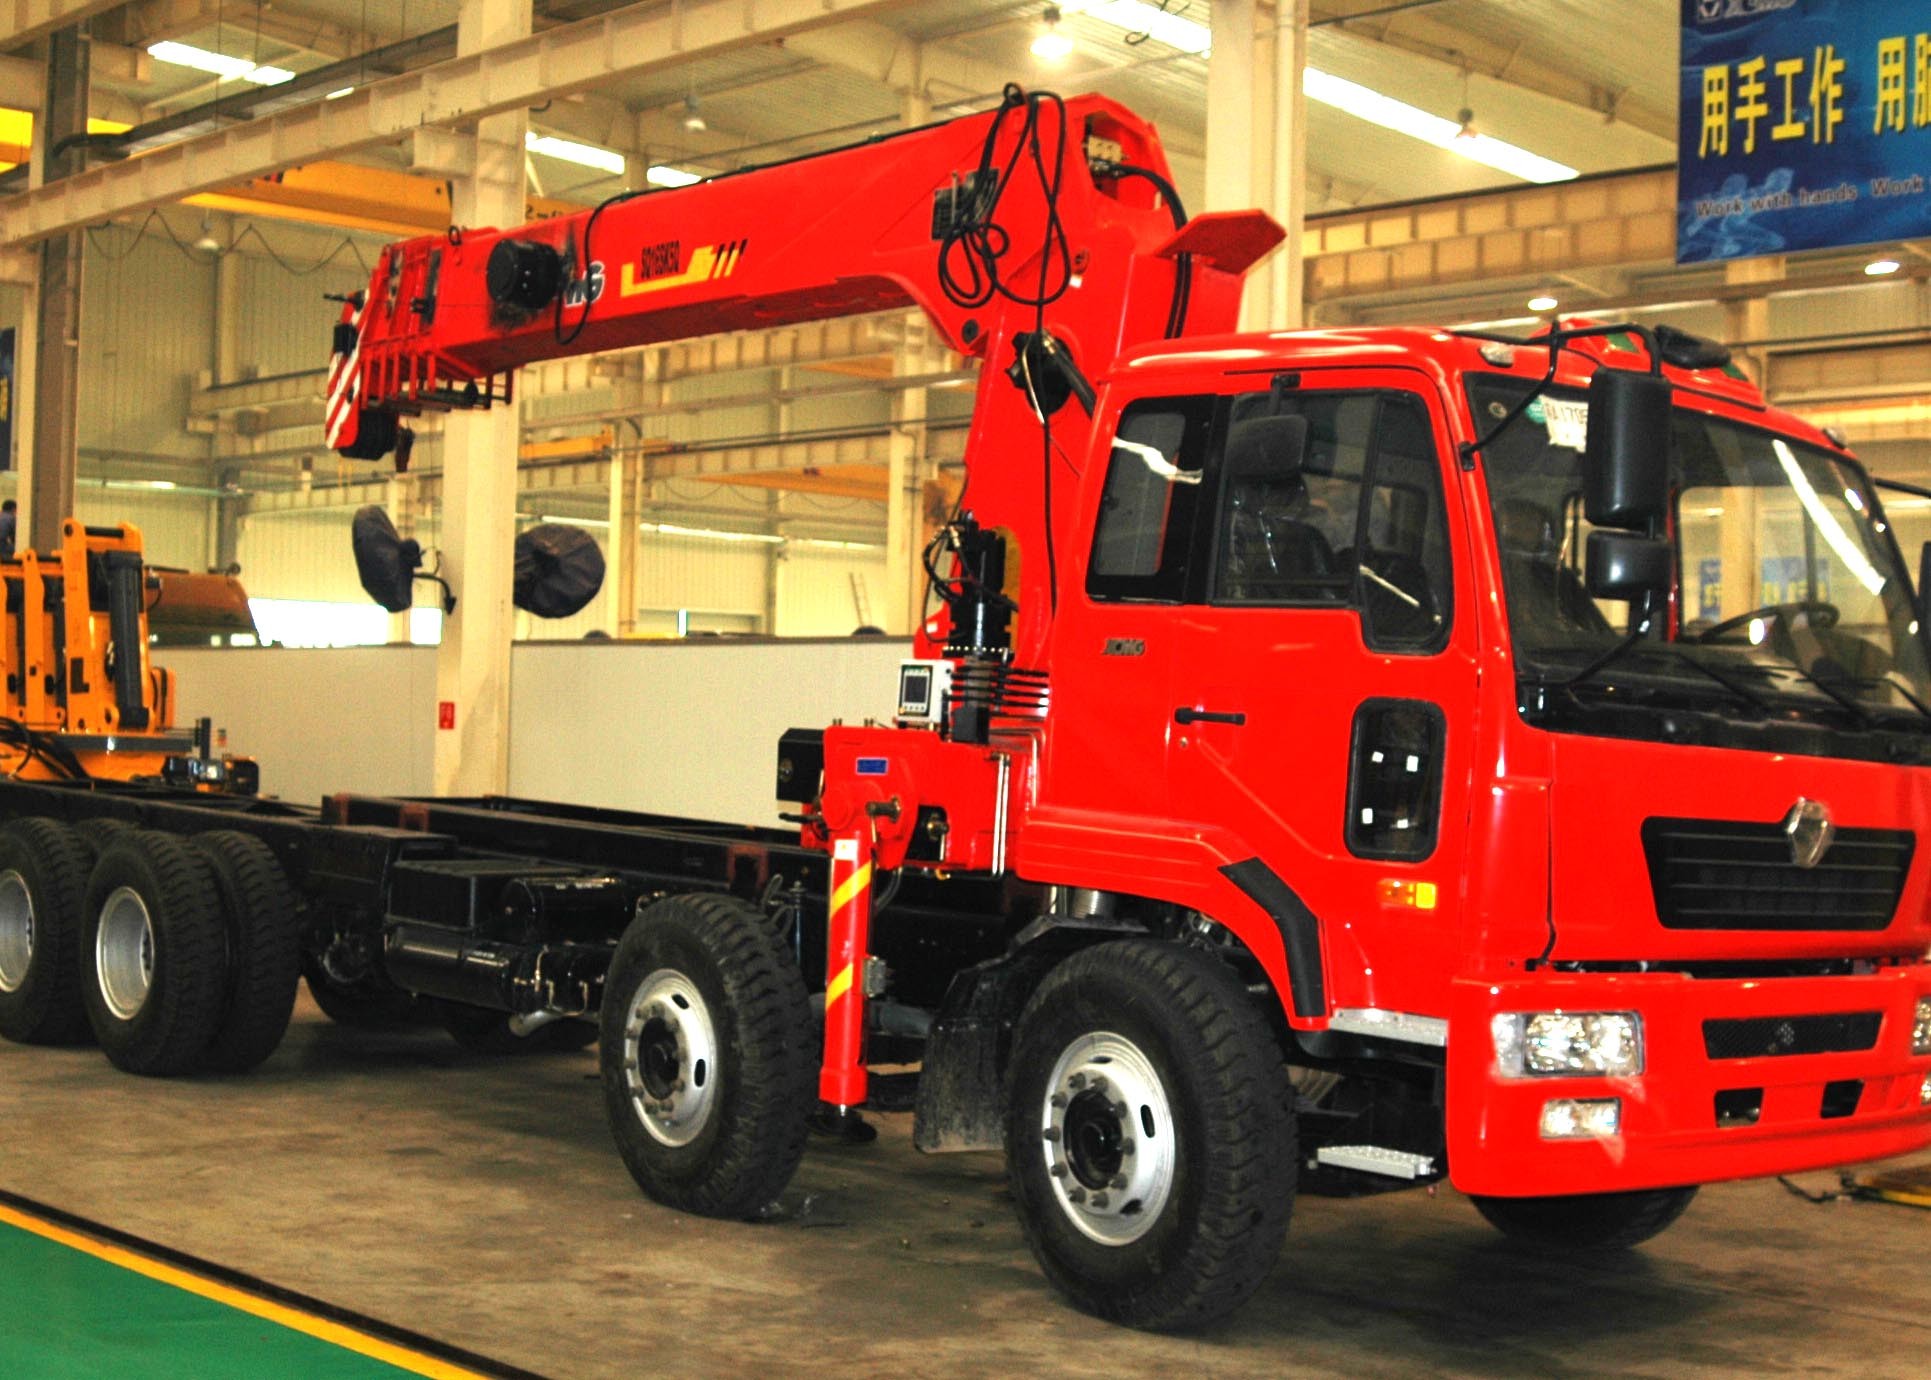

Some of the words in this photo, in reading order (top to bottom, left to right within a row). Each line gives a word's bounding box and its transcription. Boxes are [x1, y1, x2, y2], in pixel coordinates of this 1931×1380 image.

[1698, 46, 1845, 157] 用手工作
[1696, 195, 1744, 217] Work
[1751, 191, 1793, 211] with
[1798, 183, 1858, 205] hands
[1871, 174, 1925, 197] Work
